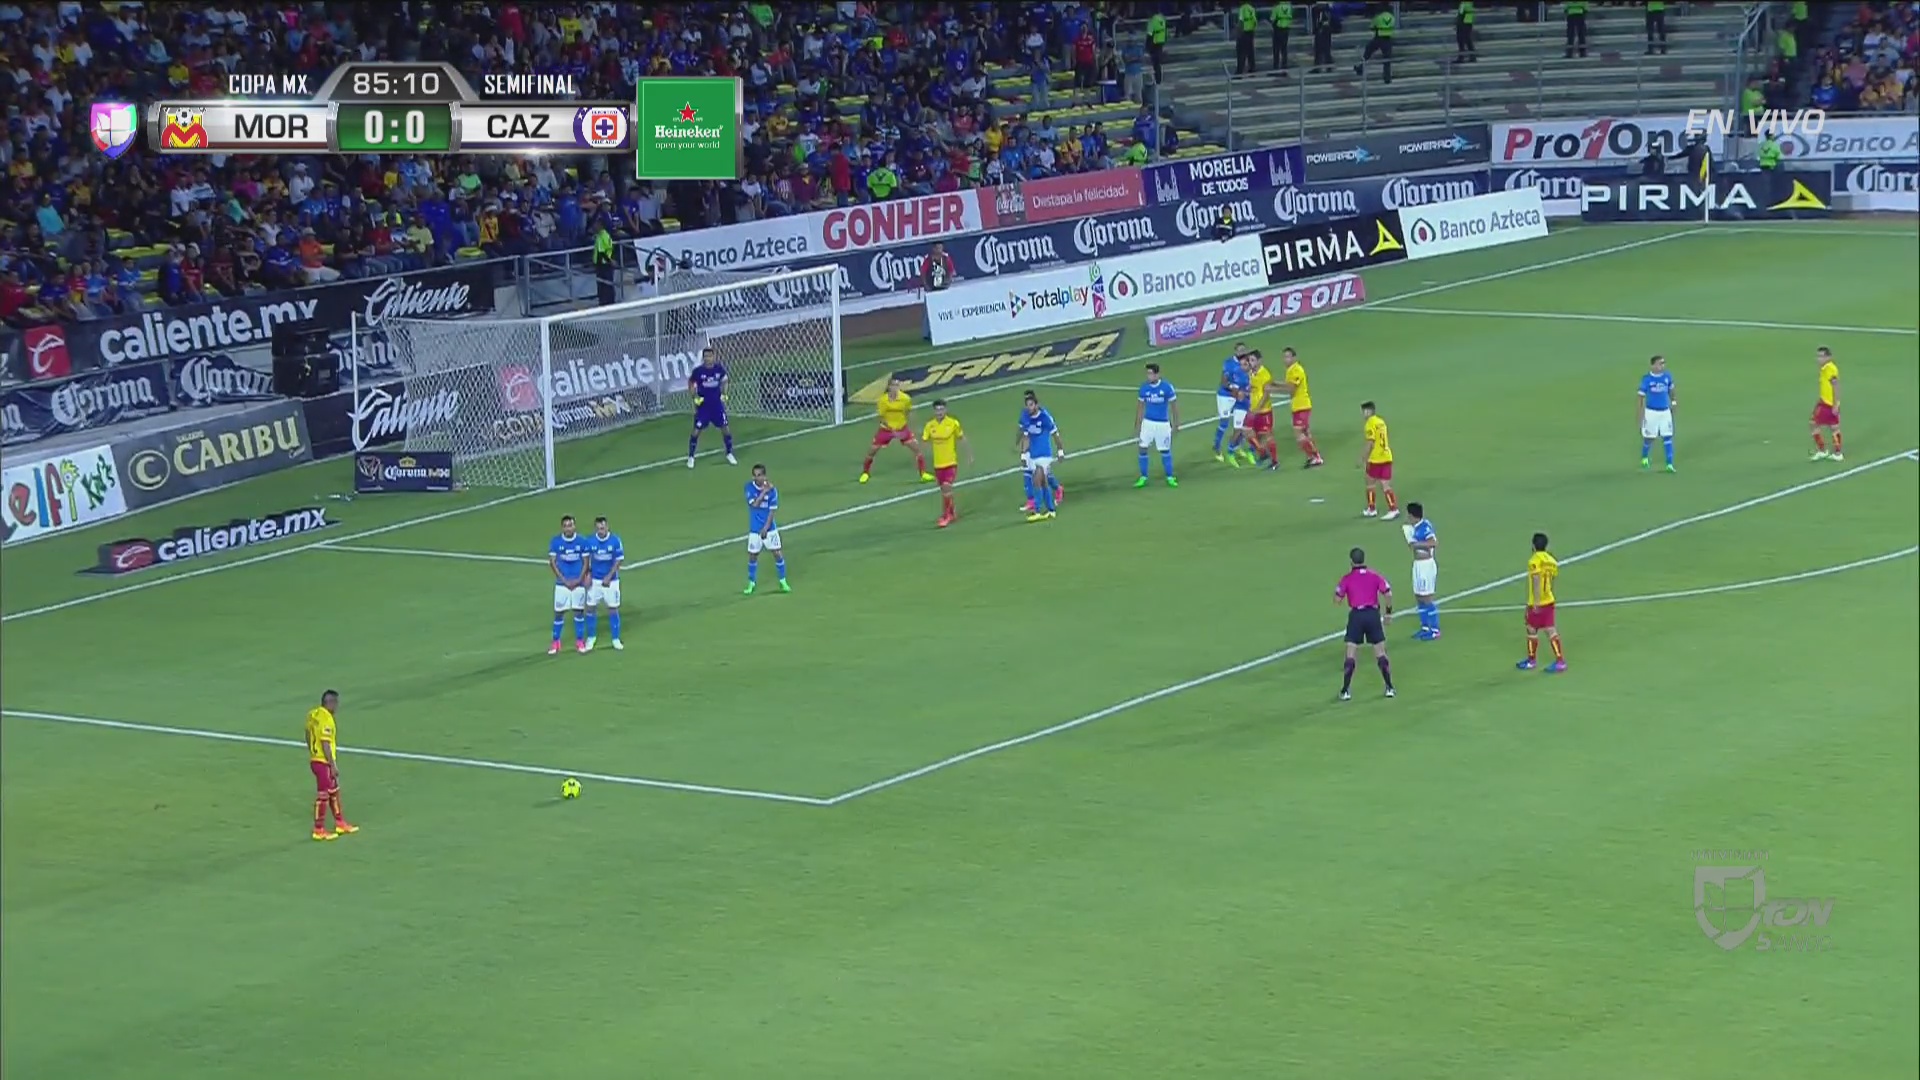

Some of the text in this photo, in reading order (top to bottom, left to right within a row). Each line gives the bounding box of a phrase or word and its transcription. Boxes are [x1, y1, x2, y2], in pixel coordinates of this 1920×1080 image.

[1815, 133, 1896, 153] Banco
[1189, 155, 1256, 180] MORELIA
[1202, 177, 1248, 196] DE TODOS
[1274, 185, 1360, 225] Corona
[1382, 177, 1475, 211] Corona
[1582, 183, 1757, 212] PIRMA
[822, 194, 965, 250] GONHER
[1073, 216, 1159, 257] Corona
[1440, 206, 1541, 240] Banco Azteca
[681, 234, 808, 269] Banco Azteca
[870, 250, 924, 292] Cor
[974, 235, 1060, 276] Corona
[1263, 229, 1366, 276] PIRMA
[1143, 257, 1260, 294] Banco Azteca
[364, 277, 471, 327] Caliente
[938, 312, 953, 321] VIVE
[962, 302, 1007, 318] EXPERIENCIA
[1028, 286, 1089, 310] Totalplay
[1201, 291, 1303, 333] LUCAS
[1310, 279, 1357, 309] OIL
[180, 356, 273, 404] Coron
[51, 376, 158, 426] Corona
[346, 386, 460, 452] Caliente
[173, 416, 300, 476] CARIBU
[384, 465, 426, 480] Corona
[158, 507, 326, 561] caliente.mx
